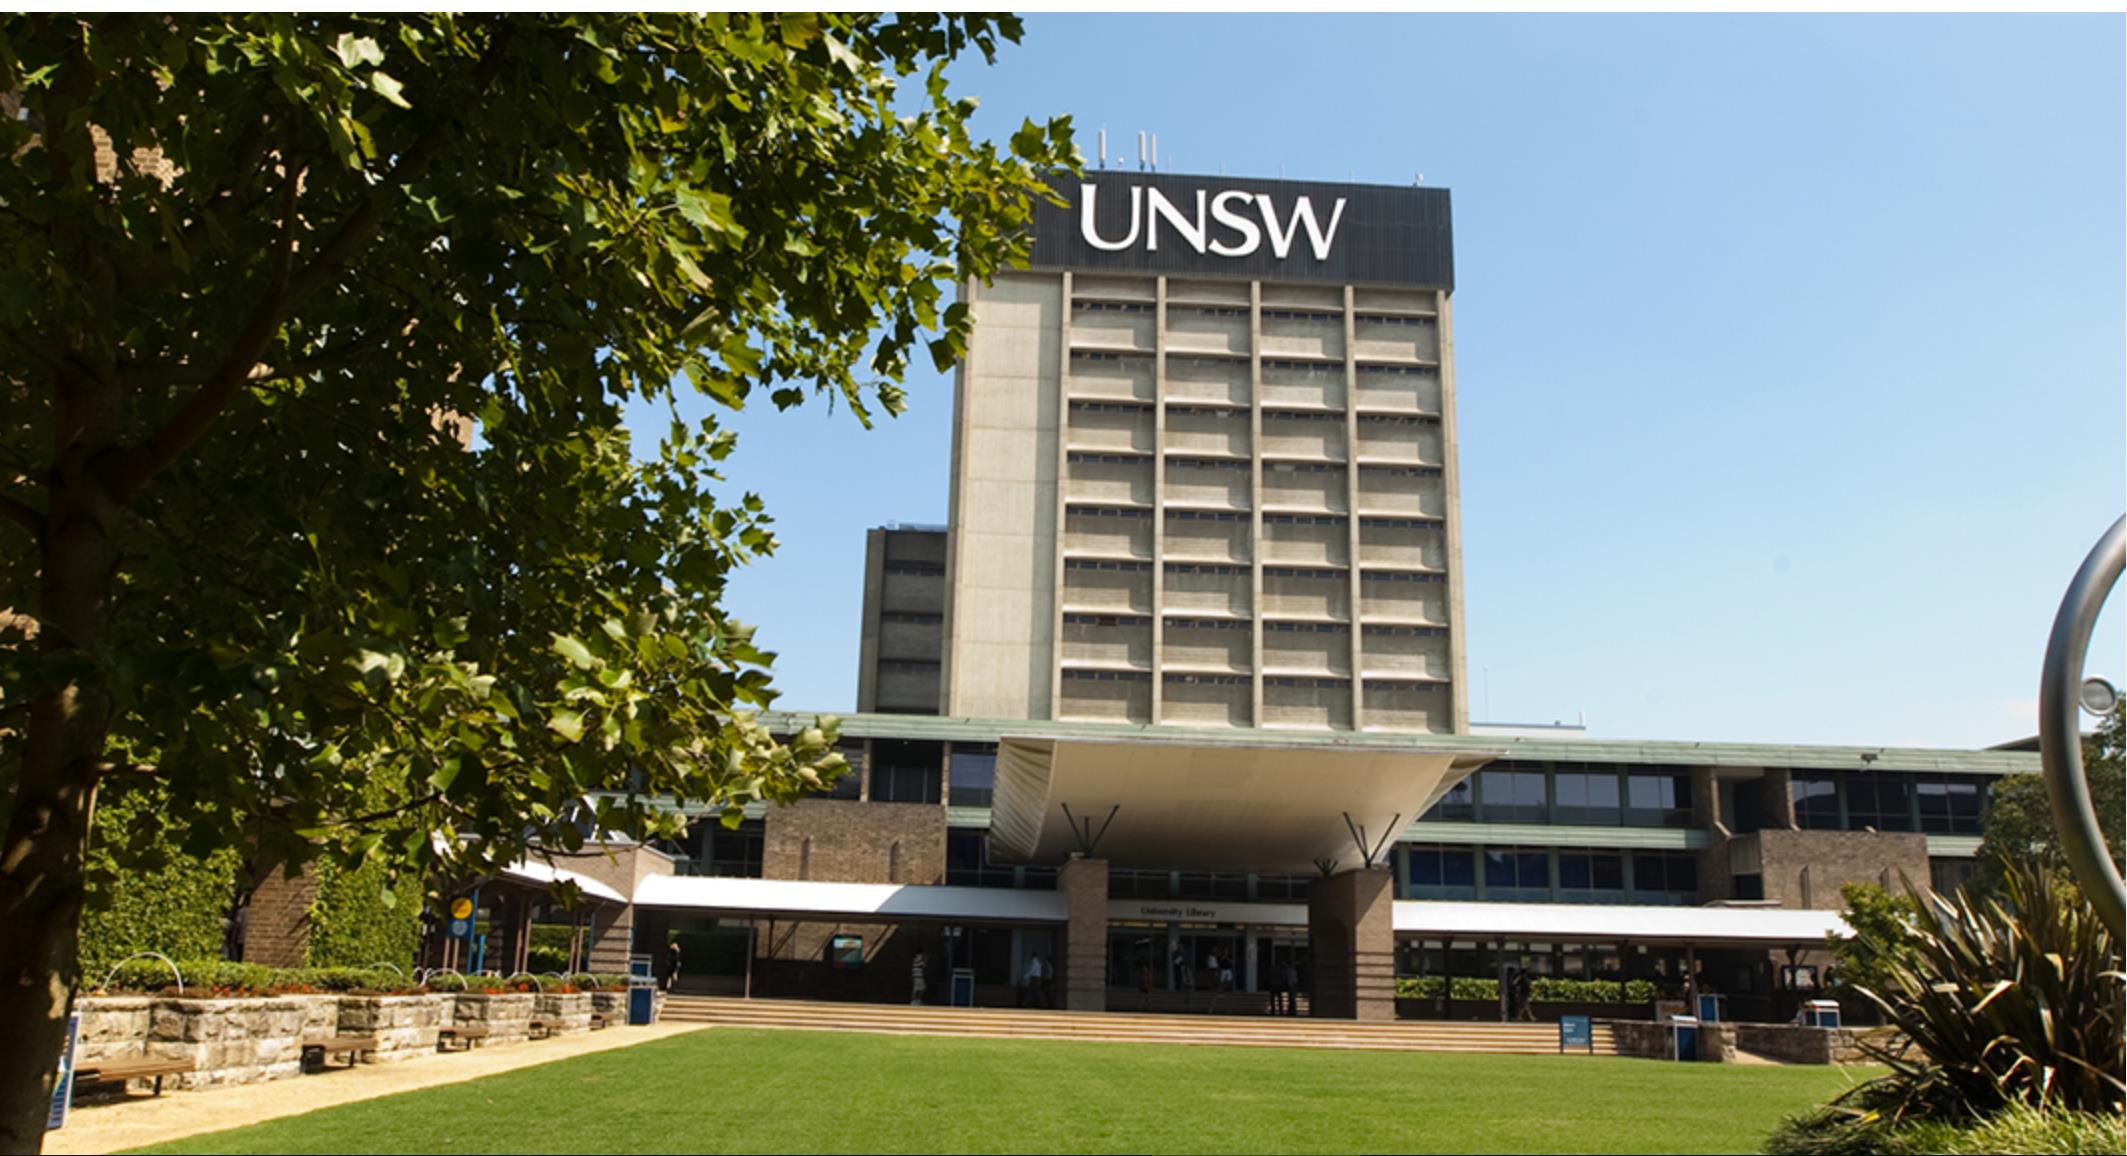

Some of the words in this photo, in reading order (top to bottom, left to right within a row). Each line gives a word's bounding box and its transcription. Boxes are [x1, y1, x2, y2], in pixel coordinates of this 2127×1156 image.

[1081, 183, 1347, 260] UNSW
[1140, 906, 1182, 917] University
[1186, 907, 1216, 918] Library
